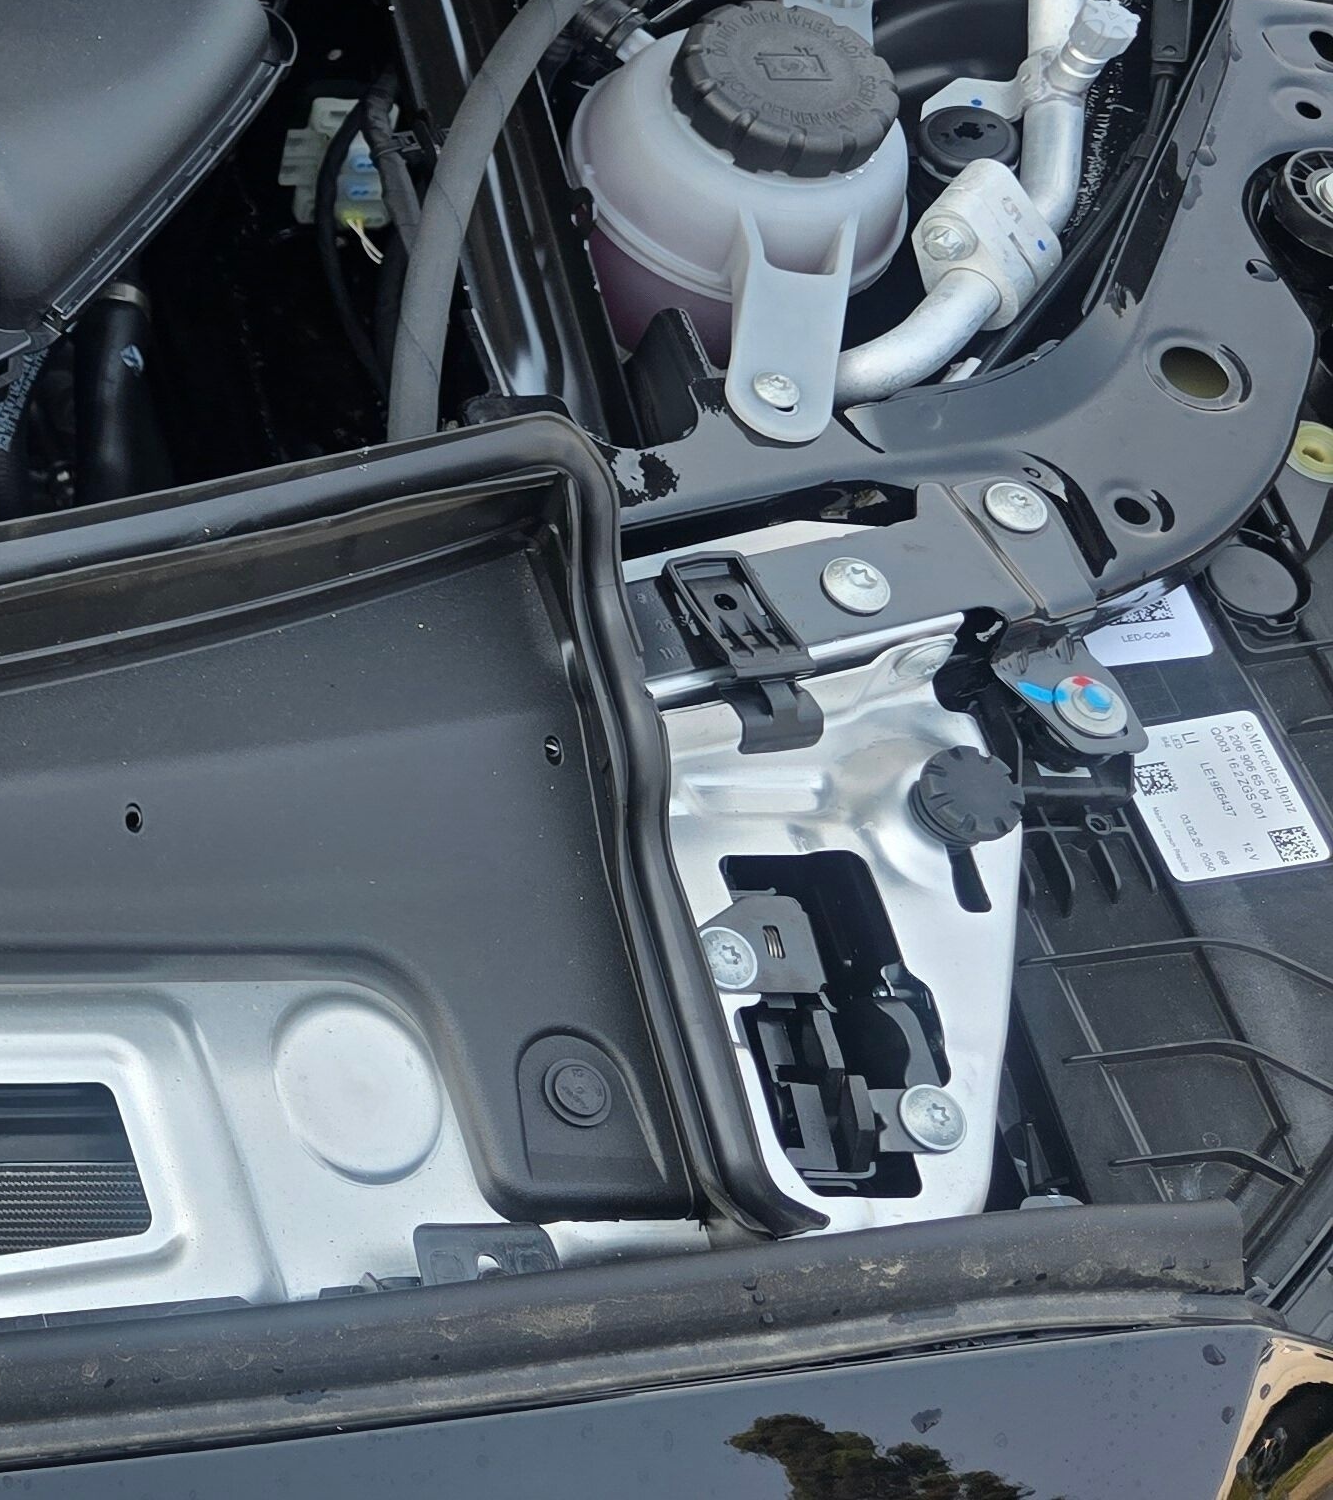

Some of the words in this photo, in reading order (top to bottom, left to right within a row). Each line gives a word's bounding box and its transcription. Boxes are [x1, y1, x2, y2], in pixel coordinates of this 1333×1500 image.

[741, 11, 781, 25] OPEN
[786, 13, 837, 39] WHEN
[836, 35, 867, 60] HOT
[1121, 631, 1171, 643] LED-Code
[1171, 735, 1183, 749] LED
[1229, 735, 1246, 752] 206
[1240, 755, 1256, 772] 906
[1251, 774, 1265, 786] 65
[1259, 789, 1272, 800] 04
[1200, 763, 1237, 816] LE19E6437
[1211, 727, 1231, 752] Q003
[1238, 779, 1257, 800] ZGS
[1251, 803, 1266, 819] 001
[1247, 734, 1297, 813] Mercedes-Benz
[1243, 843, 1253, 852] 12
